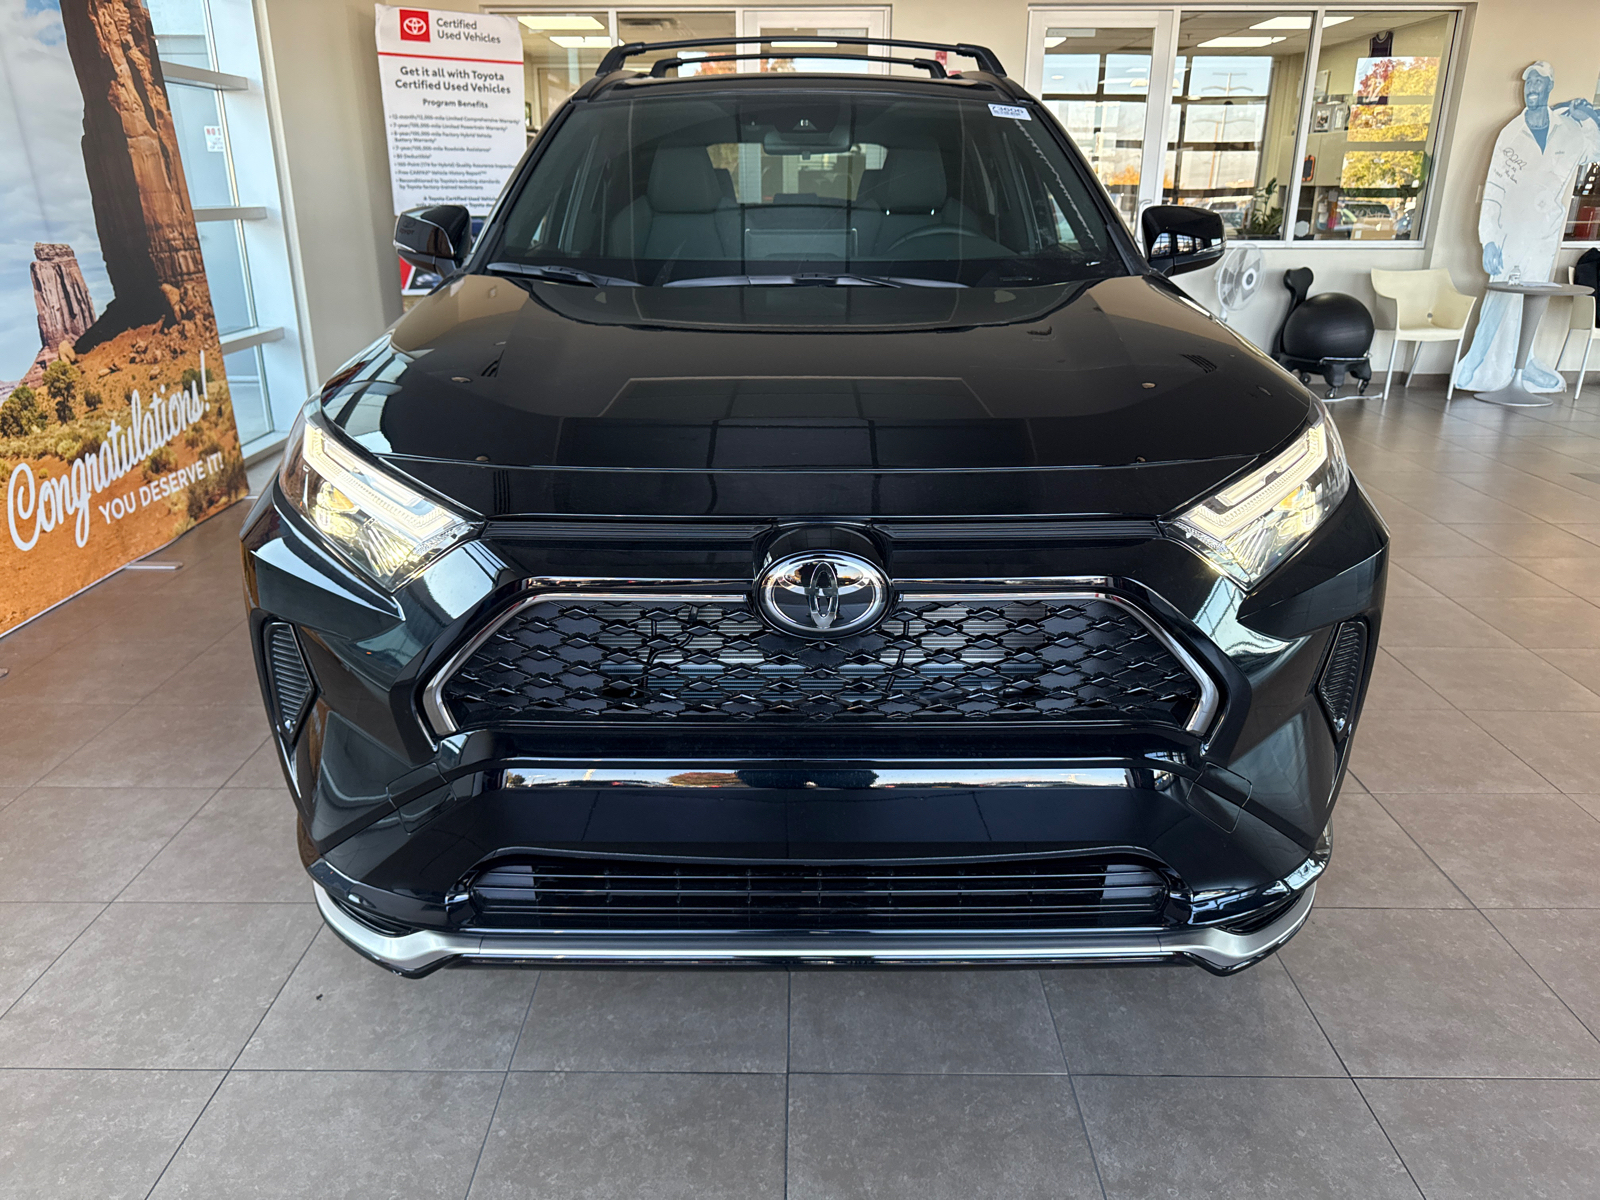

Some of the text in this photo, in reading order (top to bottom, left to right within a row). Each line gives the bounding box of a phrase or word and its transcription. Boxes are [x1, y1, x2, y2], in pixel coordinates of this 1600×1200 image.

[436, 18, 477, 30] Certified
[437, 30, 501, 44] Used Vehicles
[400, 66, 504, 82] Get it all with Toyota
[395, 80, 511, 94] Certified Used Vehicles
[422, 98, 489, 109] Program Benefits
[7, 349, 210, 551] Congratulations!
[98, 451, 225, 525] YOU DESERVE IT!
